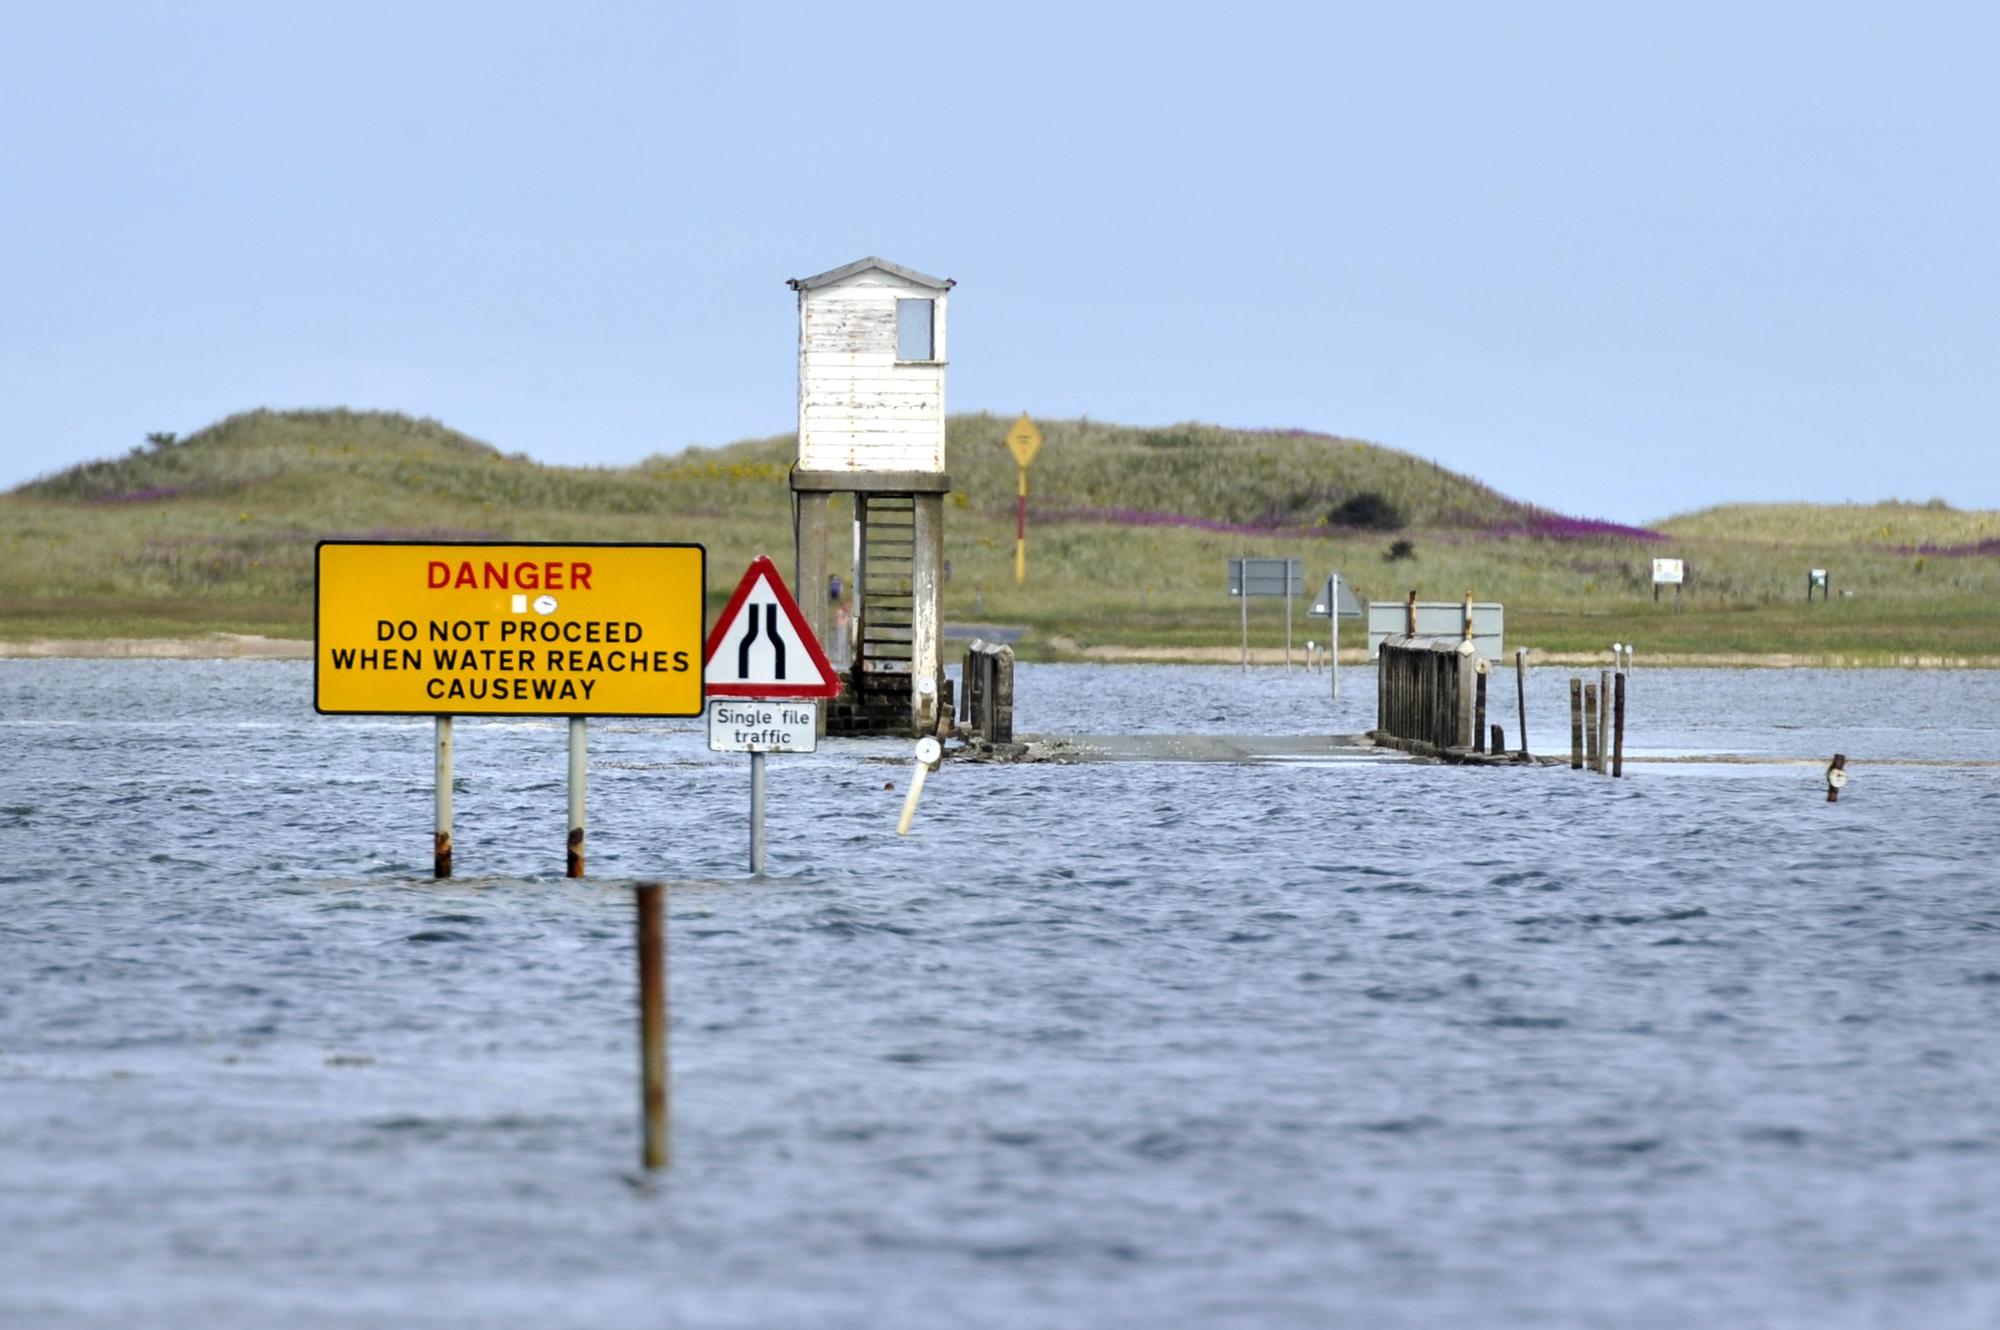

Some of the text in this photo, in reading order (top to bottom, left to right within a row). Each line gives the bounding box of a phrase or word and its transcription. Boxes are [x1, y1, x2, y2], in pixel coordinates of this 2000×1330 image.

[427, 560, 593, 590] DANGER
[377, 620, 642, 643] DO NOT PROCEED
[332, 649, 689, 673] WHEN WATER REACHES
[426, 678, 596, 700] CAUSEWAY
[717, 708, 810, 727] Single file
[734, 729, 791, 743] traffic
